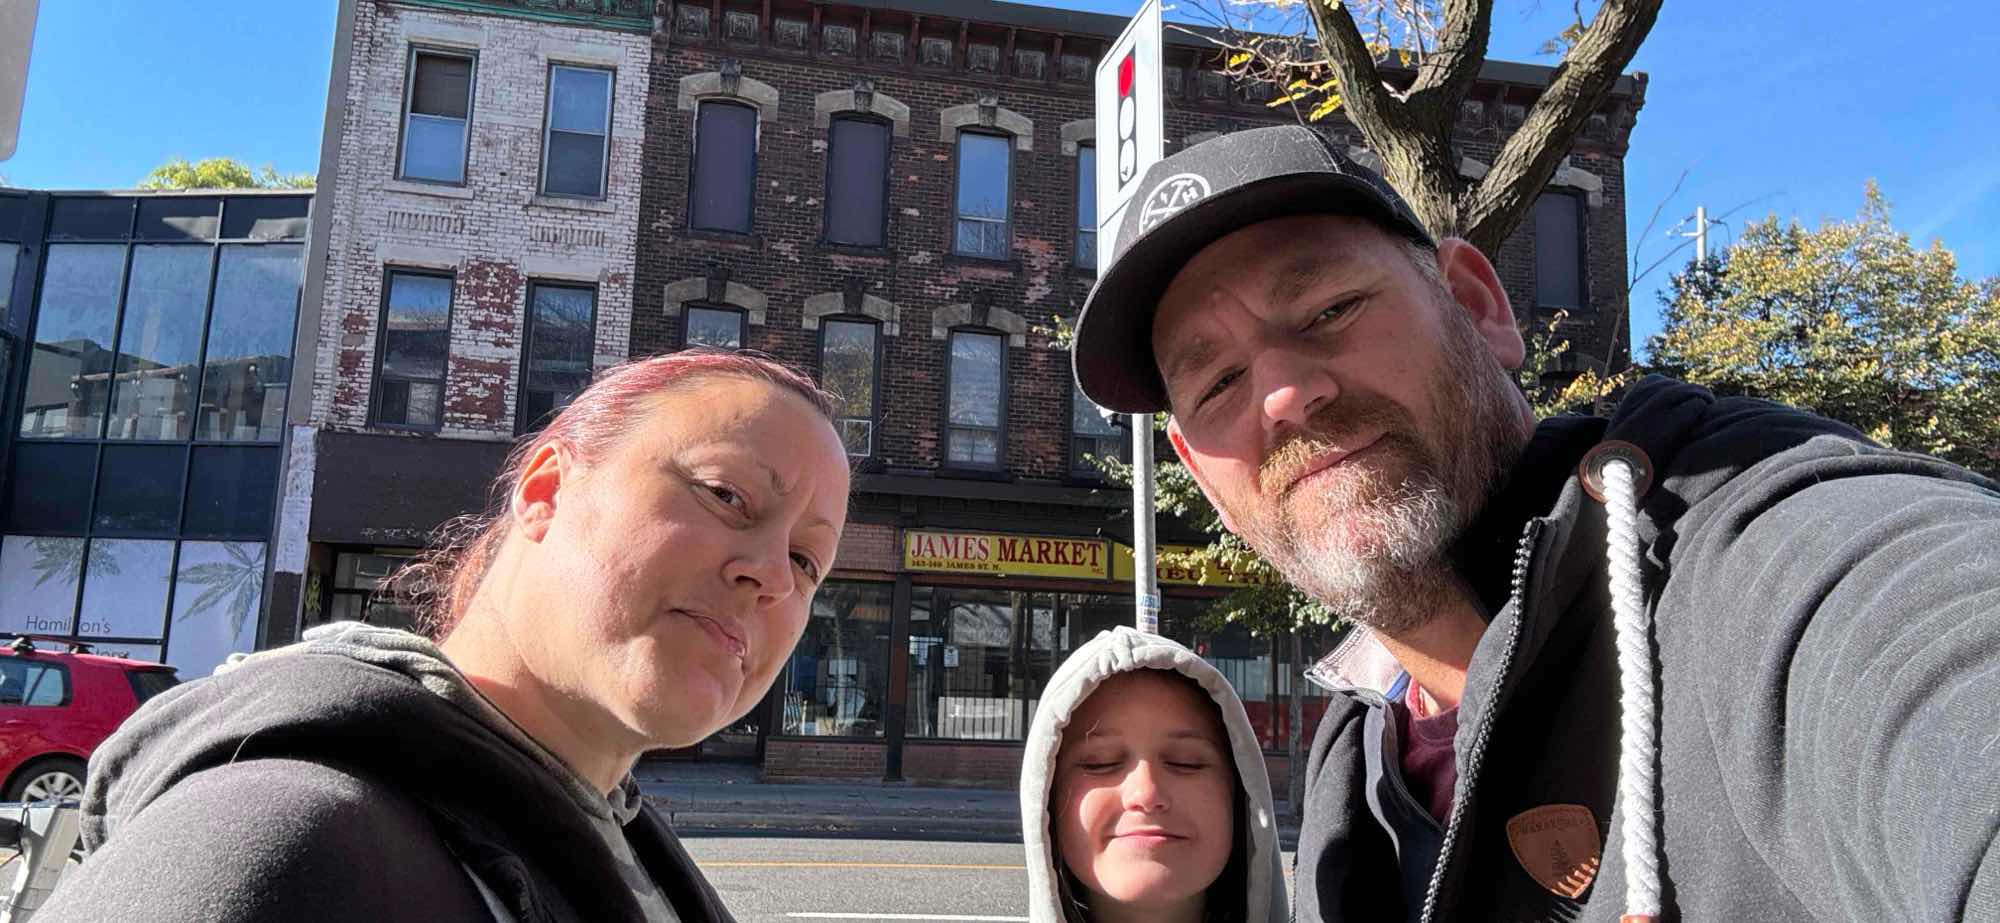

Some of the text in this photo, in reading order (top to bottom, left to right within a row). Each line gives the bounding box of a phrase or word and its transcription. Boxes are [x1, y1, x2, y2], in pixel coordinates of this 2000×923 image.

[911, 534, 1102, 567] JAMES MARKET
[25, 615, 112, 633] Hamilon's
